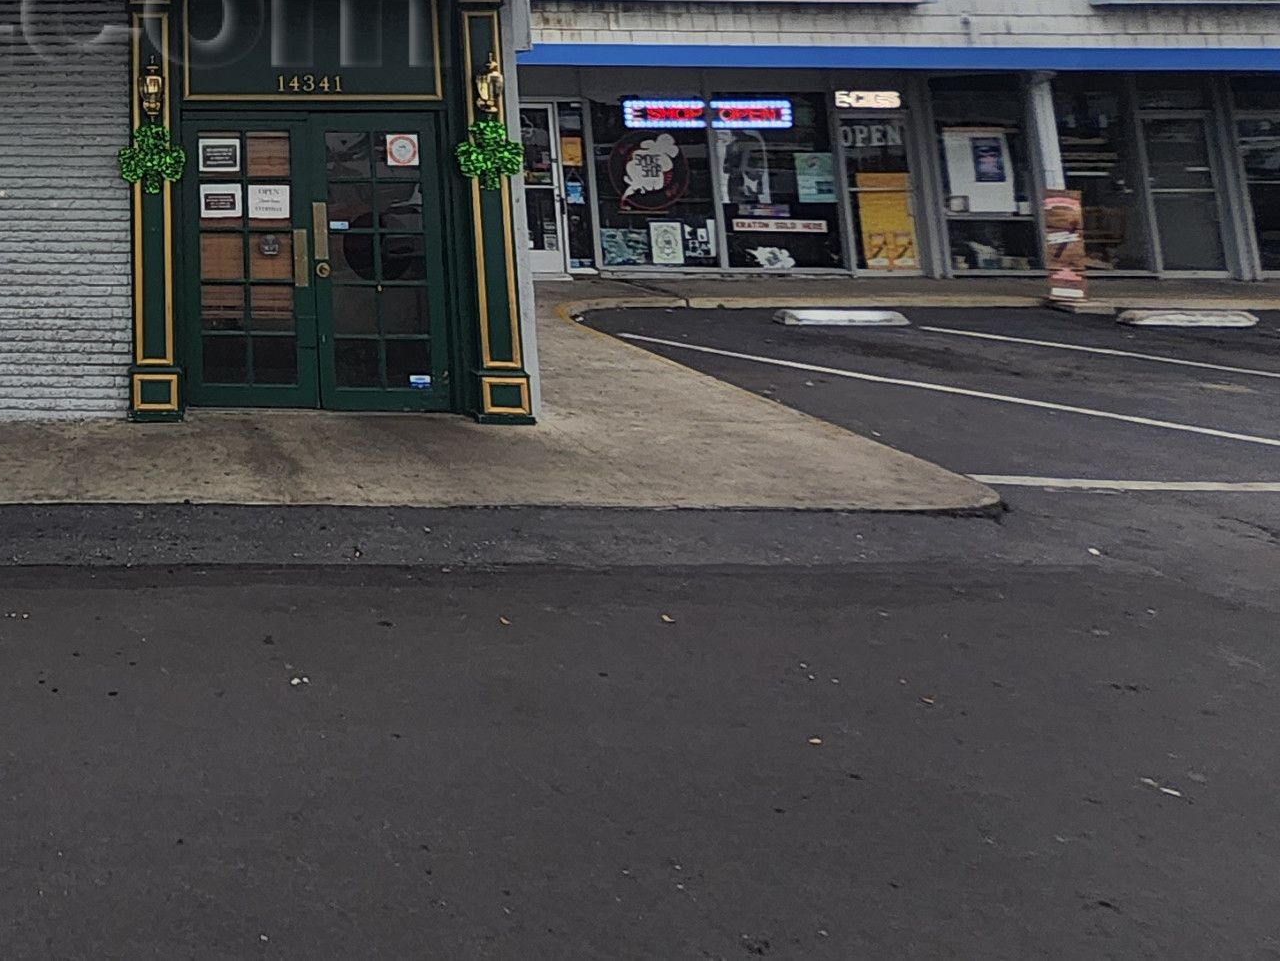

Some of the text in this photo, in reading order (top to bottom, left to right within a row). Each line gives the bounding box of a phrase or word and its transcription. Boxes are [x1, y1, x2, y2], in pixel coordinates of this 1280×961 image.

[277, 74, 342, 92] 14341
[719, 105, 777, 123] OPEN
[839, 124, 904, 147] OPEN
[774, 221, 797, 230] SOLD
